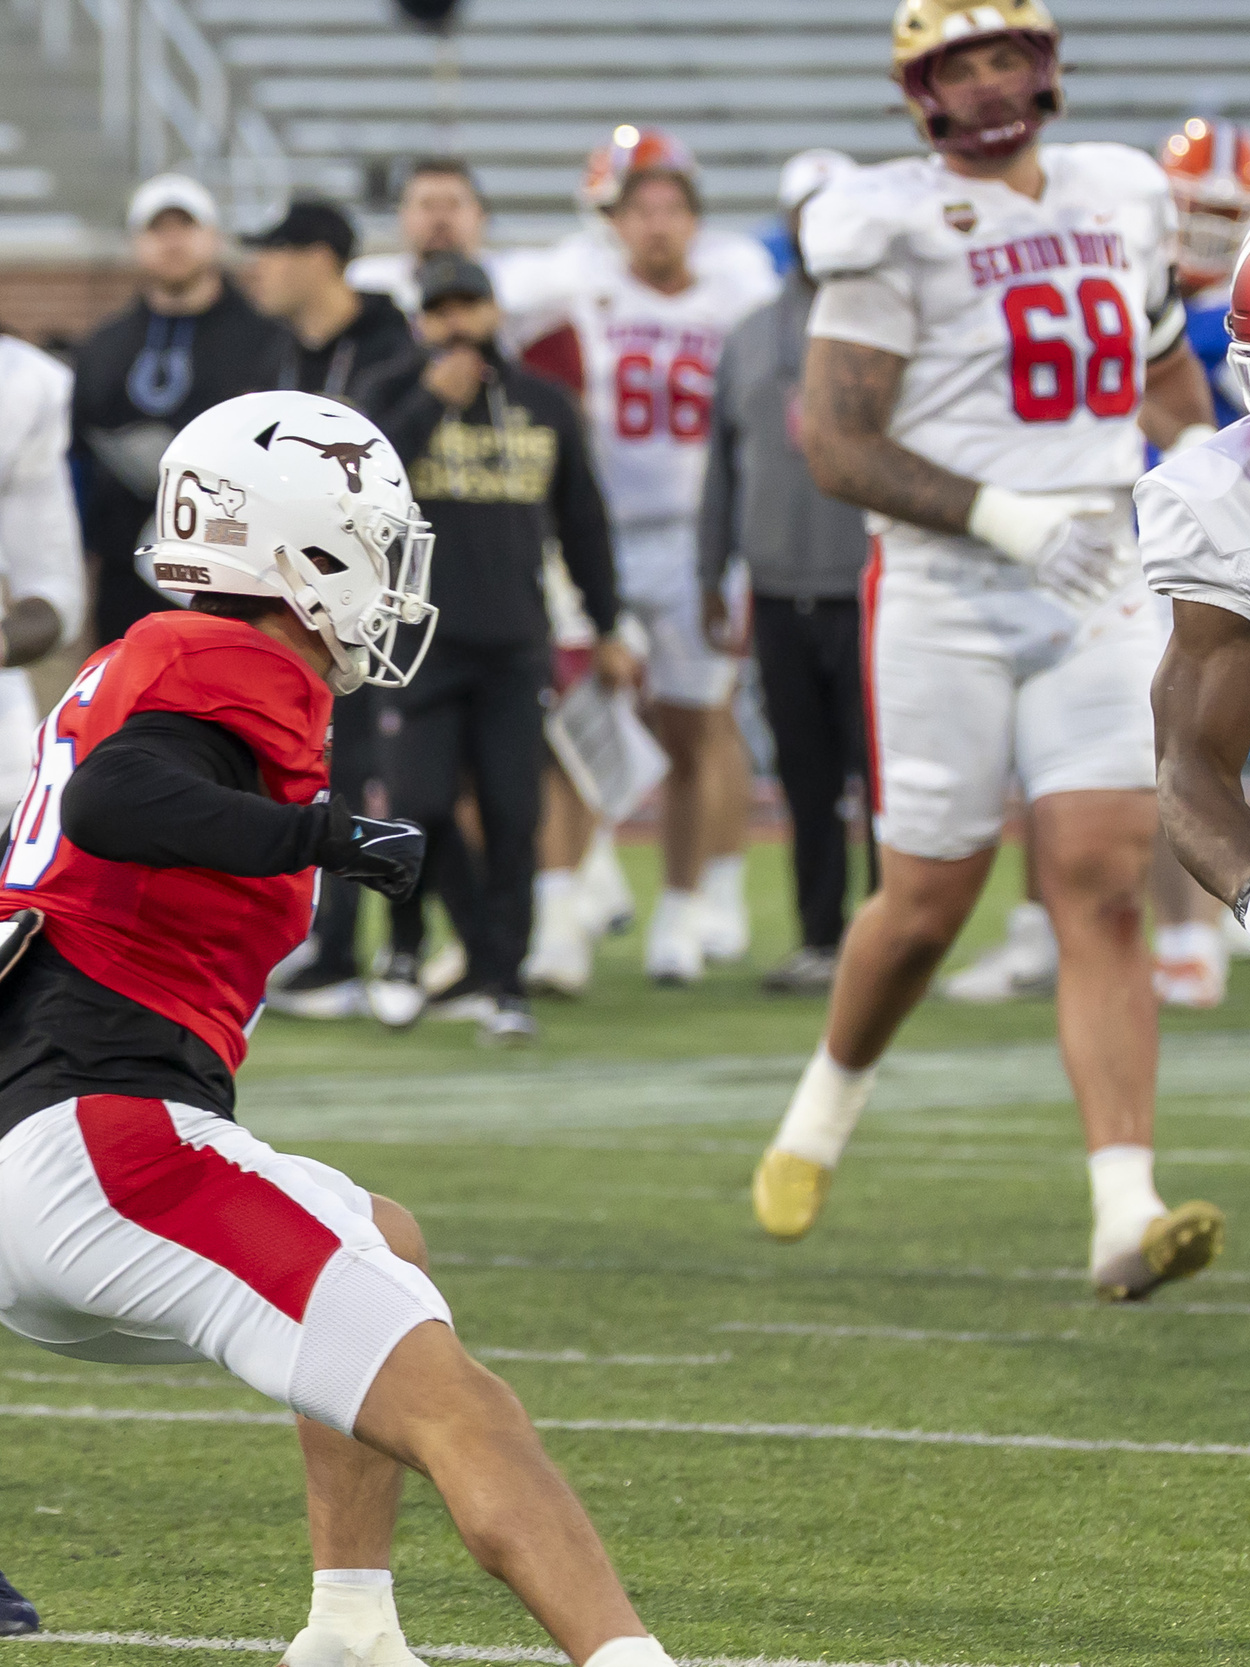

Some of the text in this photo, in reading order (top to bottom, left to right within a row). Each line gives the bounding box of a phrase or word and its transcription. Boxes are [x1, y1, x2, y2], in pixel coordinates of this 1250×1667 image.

[1003, 277, 1138, 423] 68
[614, 353, 715, 438] 66
[160, 467, 200, 540] 16
